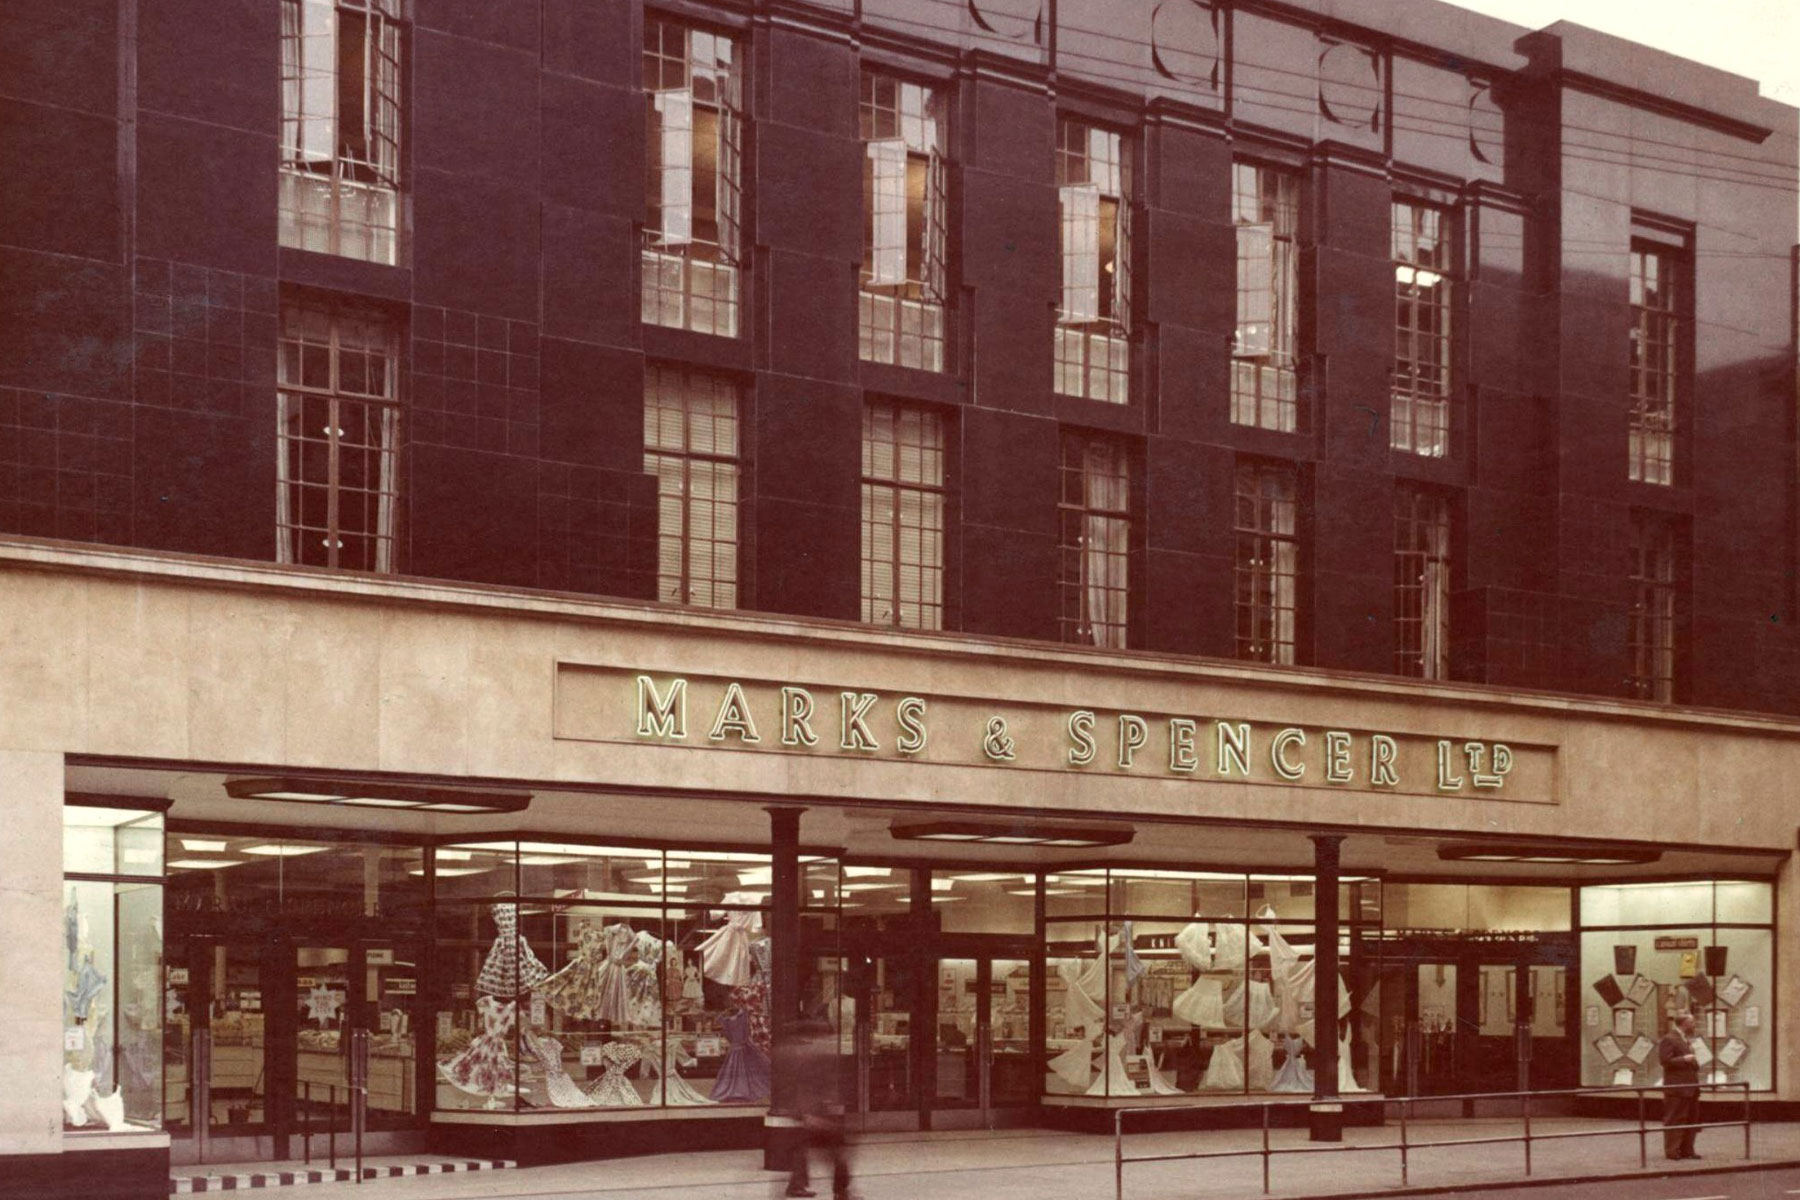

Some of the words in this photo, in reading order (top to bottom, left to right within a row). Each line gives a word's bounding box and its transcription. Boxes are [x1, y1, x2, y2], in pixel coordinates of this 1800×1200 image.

[637, 675, 926, 754] MARKS
[984, 715, 1015, 760] &
[1068, 710, 1399, 786] SPENCER
